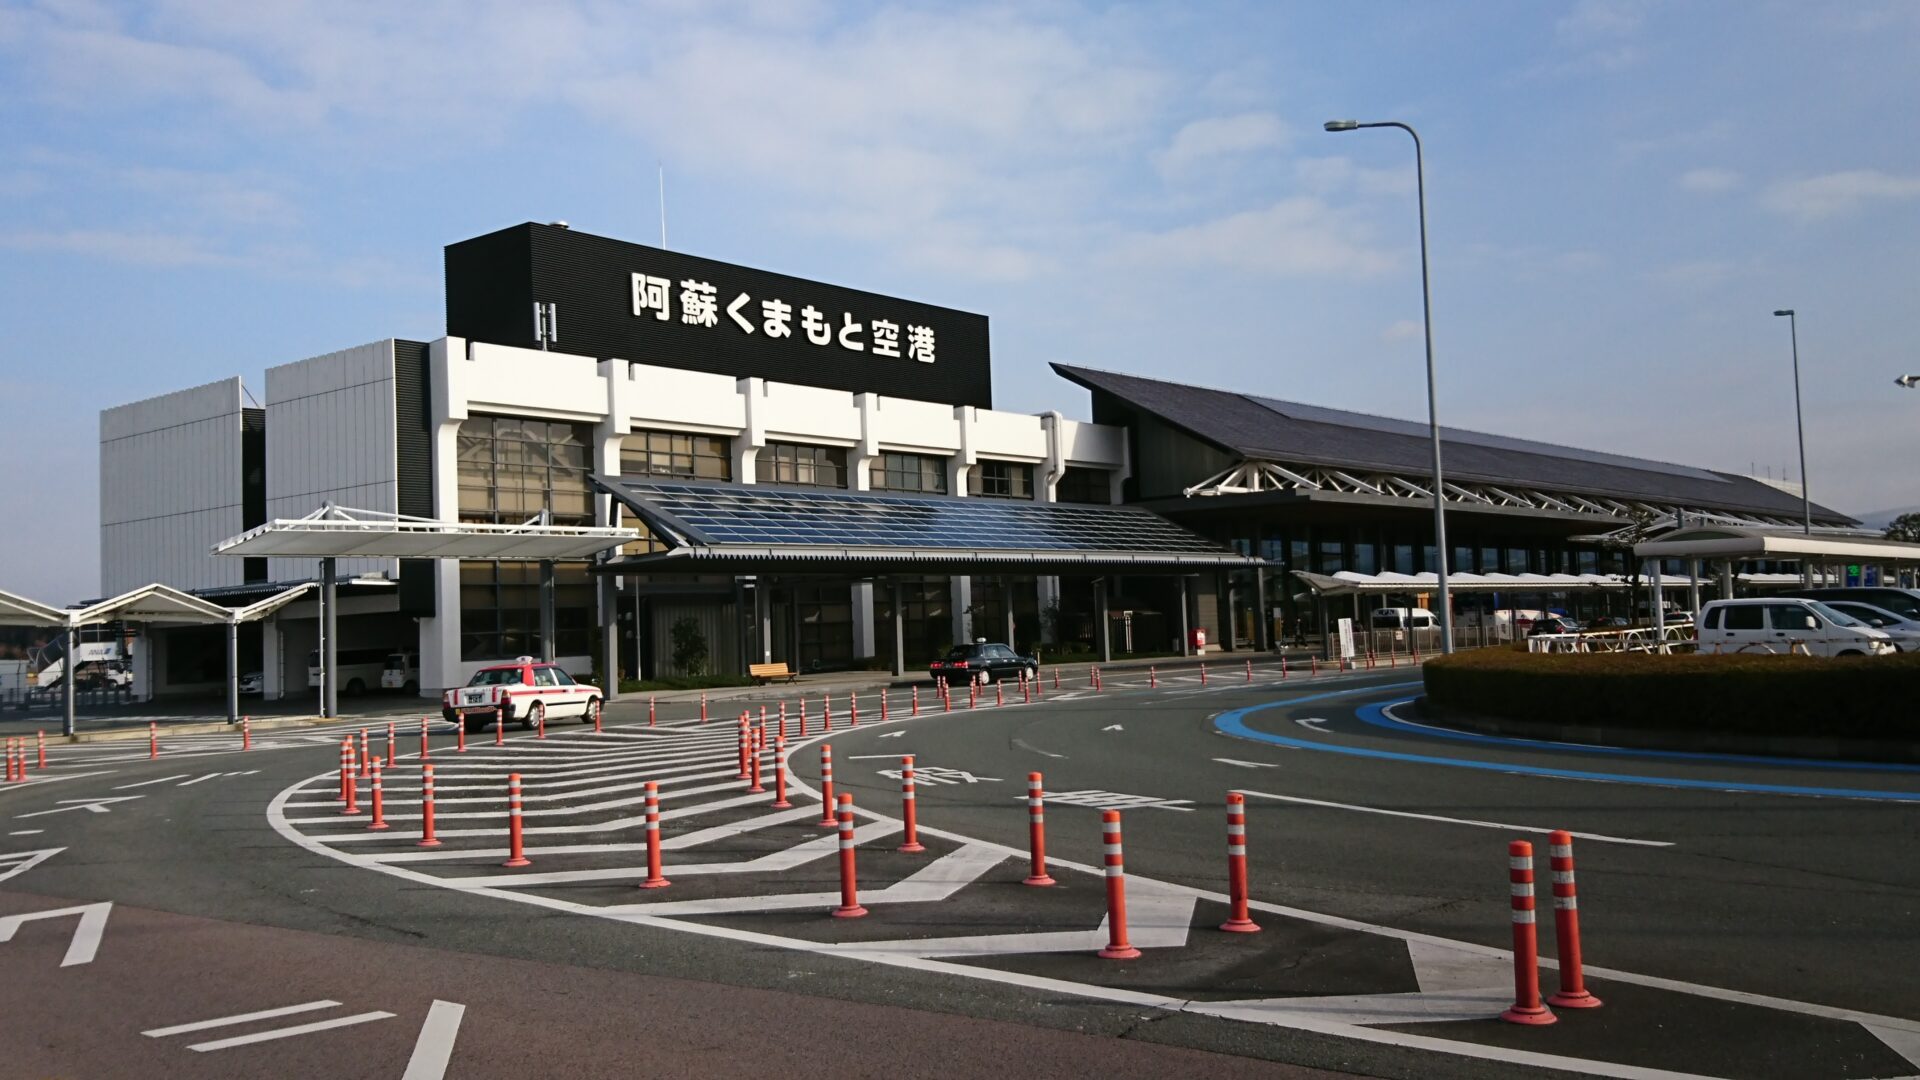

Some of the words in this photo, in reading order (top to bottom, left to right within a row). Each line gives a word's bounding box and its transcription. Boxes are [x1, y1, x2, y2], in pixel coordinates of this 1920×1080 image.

[631, 272, 936, 363] 阿蘇くまもと空港
